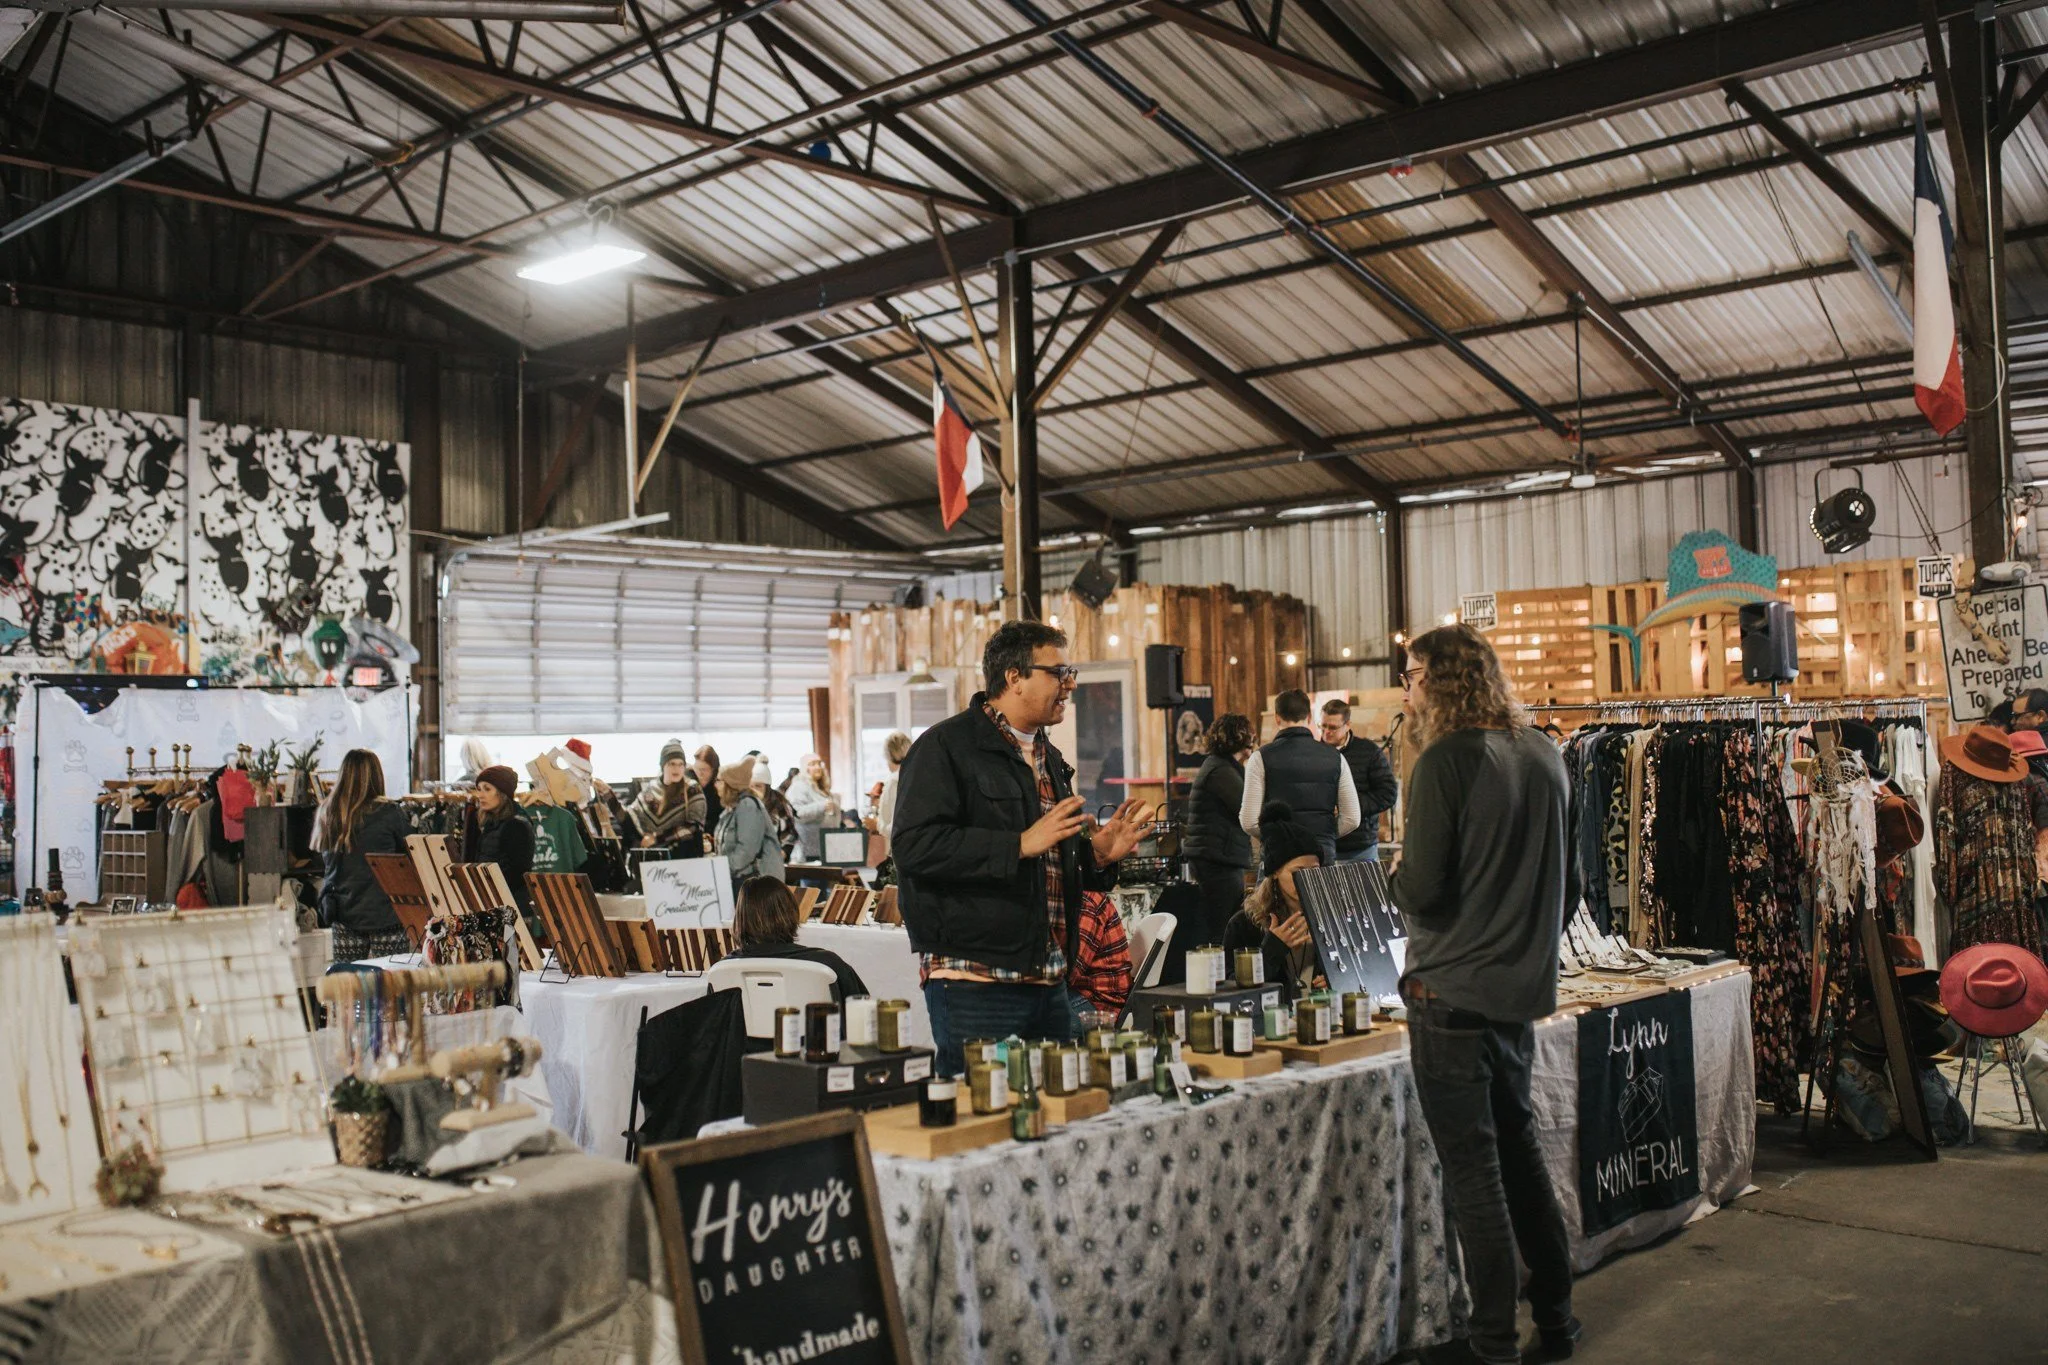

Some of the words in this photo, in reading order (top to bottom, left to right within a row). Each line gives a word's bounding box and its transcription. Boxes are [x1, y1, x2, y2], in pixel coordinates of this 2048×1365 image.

[1918, 562, 1953, 583] TUPPS
[1463, 598, 1495, 616] TUPPS
[1962, 661, 2043, 688] Prepared
[1966, 691, 1985, 709] To
[647, 866, 678, 883] More
[655, 900, 699, 917] Creations
[1608, 1007, 1669, 1079] Lynn
[1596, 1136, 1689, 1203] MINERAL
[691, 1177, 853, 1264] Henry's
[698, 1236, 863, 1304] DAUGHTER
